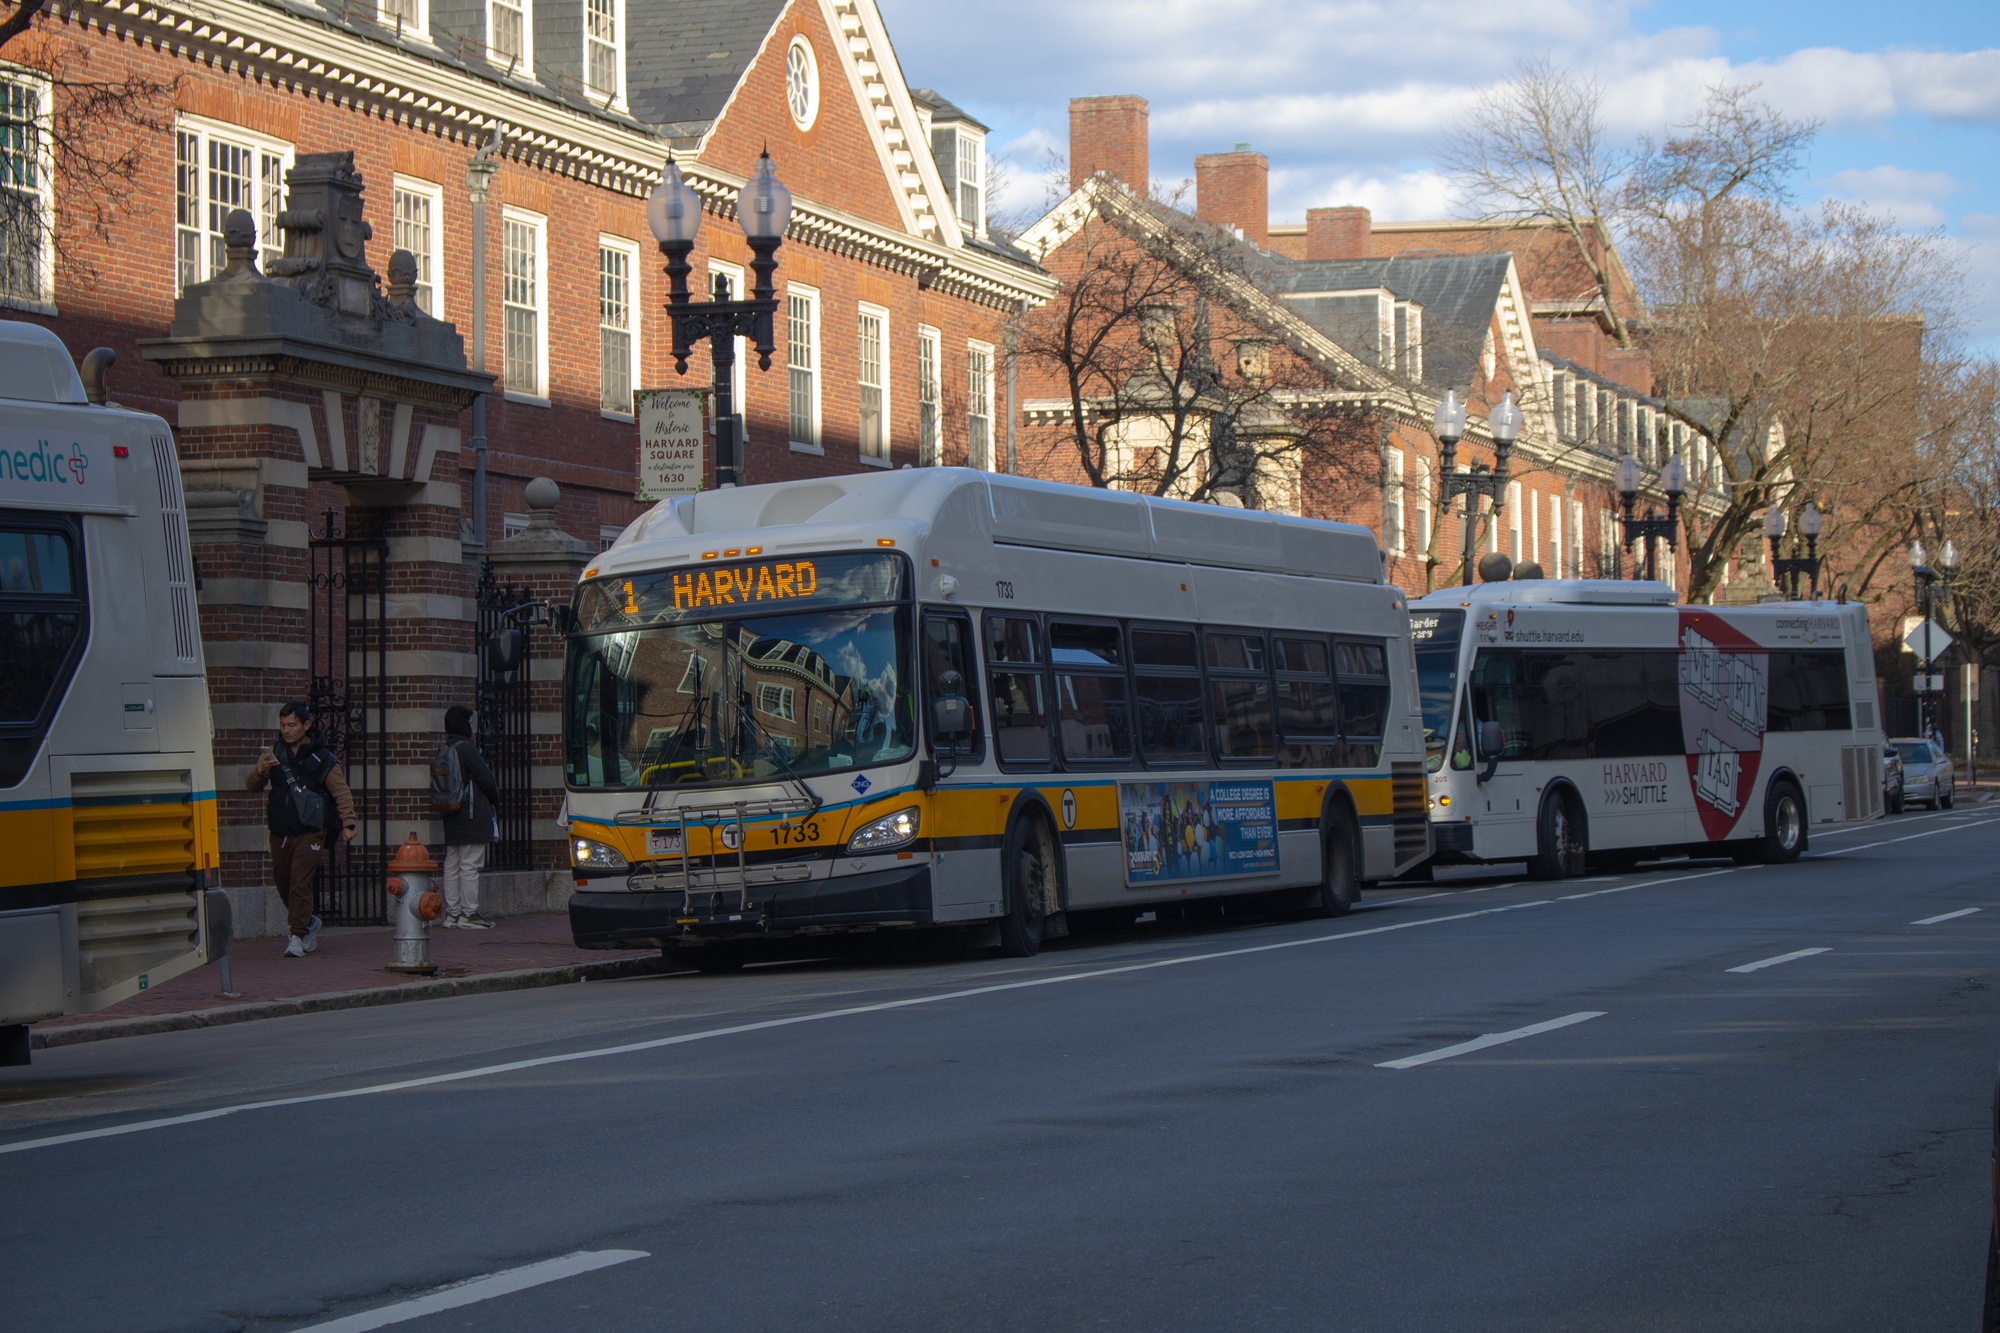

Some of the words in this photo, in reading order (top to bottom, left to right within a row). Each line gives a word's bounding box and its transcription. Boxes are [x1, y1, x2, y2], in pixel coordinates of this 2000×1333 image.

[651, 395, 691, 410] Welcome
[668, 411, 675, 419] to
[655, 421, 690, 435] Historic
[645, 438, 699, 449] HARVARD
[650, 450, 694, 460] SQUARE
[653, 462, 681, 471] destination
[659, 473, 684, 483] 1630
[623, 580, 638, 613] 1
[673, 562, 816, 609] HARVARD
[995, 580, 1014, 599] 1733
[1476, 621, 1497, 630] HEIGHT
[1515, 630, 1584, 643] shuttle.harvard.edu
[1603, 762, 1667, 784] HARVARD
[853, 780, 869, 788] CNG
[1210, 789, 1215, 801] A
[1215, 788, 1241, 801] COLLEGE
[1242, 788, 1263, 800] DEGREE
[1264, 788, 1270, 800] IS
[1623, 785, 1667, 804] SHUTTLE
[1217, 808, 1234, 821] MORE
[1235, 807, 1271, 820] AFFORDABLE
[770, 822, 820, 845] 1733
[1240, 827, 1256, 839] THAN
[1257, 826, 1273, 838] EVER!
[663, 836, 681, 849] 173
